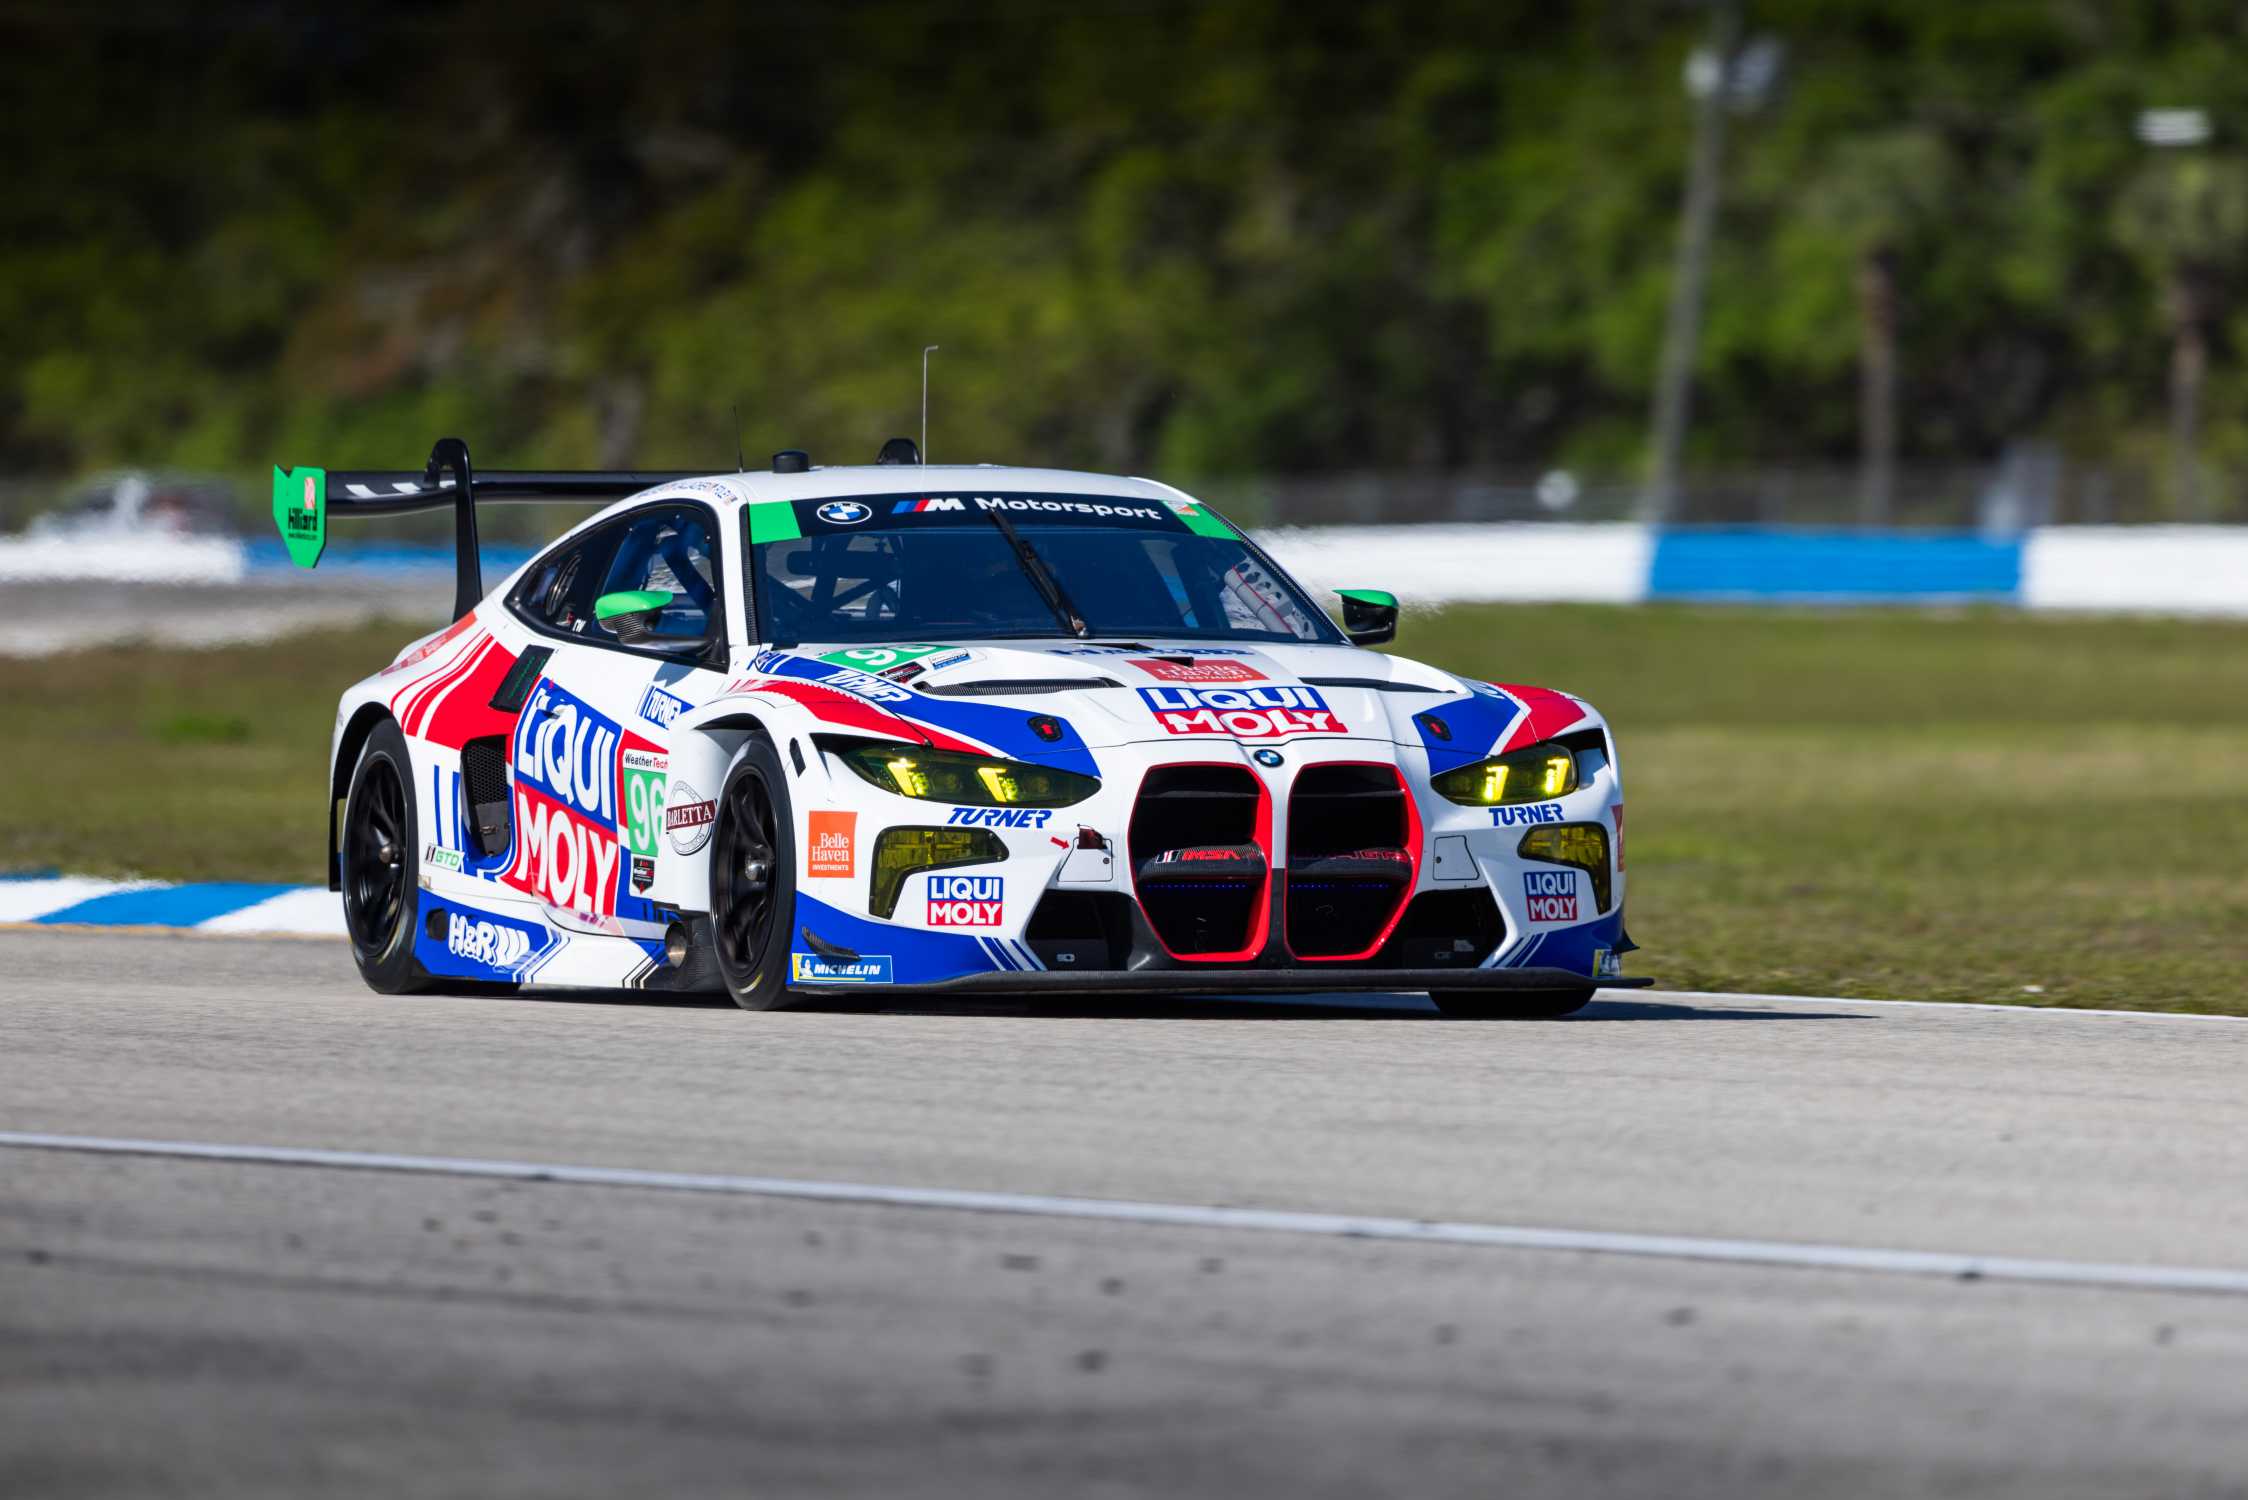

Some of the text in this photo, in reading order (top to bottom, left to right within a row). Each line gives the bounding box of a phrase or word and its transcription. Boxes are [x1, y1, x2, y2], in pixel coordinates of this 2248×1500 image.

[974, 497, 1162, 520] Motorsport
[1144, 687, 1325, 710] LIQUI
[1164, 708, 1331, 737] MOLY
[518, 687, 615, 821] LIQUI
[667, 805, 713, 828] BARLETTA
[947, 807, 1053, 829] TURNER
[1488, 803, 1565, 827] TURNER
[820, 832, 849, 848] Belle
[435, 851, 460, 867] GTD
[514, 792, 618, 914] MOLY
[812, 846, 849, 862] Haven
[930, 877, 1000, 901] LIQUI
[1525, 873, 1575, 896] LIQUI
[930, 902, 1001, 925] MOLY
[1529, 897, 1577, 921] MOLY
[814, 963, 881, 975] MICHELIN
